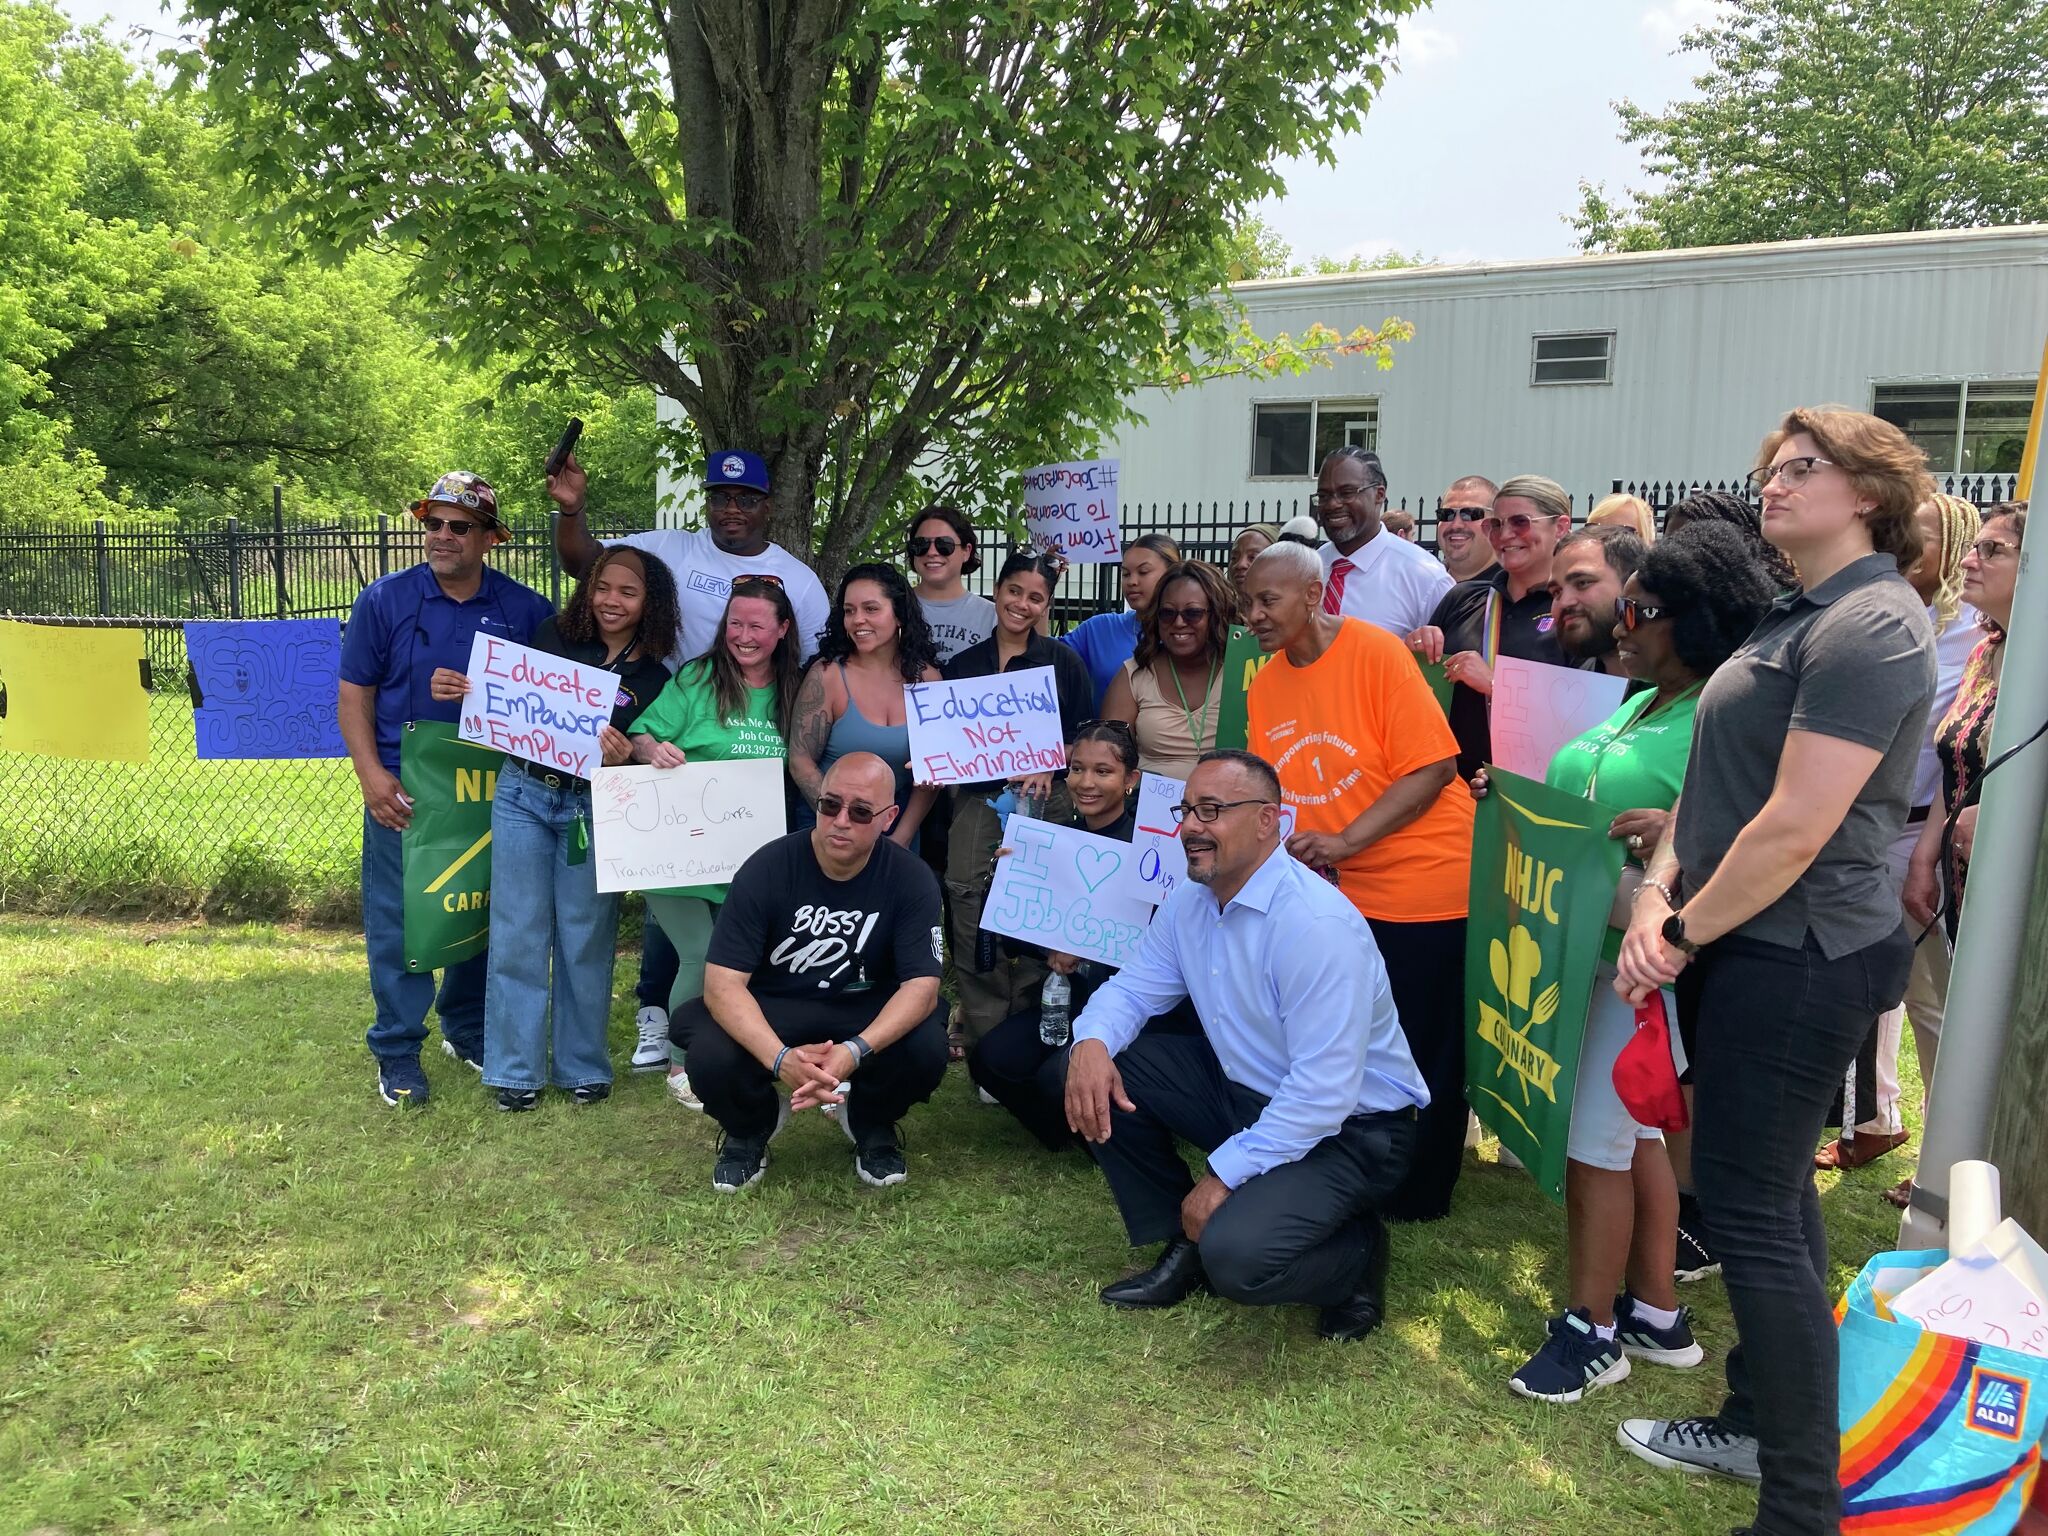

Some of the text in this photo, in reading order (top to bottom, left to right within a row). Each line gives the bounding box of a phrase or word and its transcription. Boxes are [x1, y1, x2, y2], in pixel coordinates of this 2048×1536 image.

[1066, 527, 1119, 555] From
[693, 574, 733, 597] LEV
[930, 623, 981, 645] THA'S
[484, 638, 607, 709] Educate.
[908, 675, 1058, 726] Education
[726, 717, 778, 730] Ask Me Ab
[738, 730, 757, 741] Job
[963, 721, 1022, 748] Not
[923, 740, 1068, 784] Elimination
[1273, 732, 1321, 774] Empowering
[1322, 731, 1358, 757] Futures
[1311, 756, 1324, 782] 1
[1338, 768, 1363, 791] Time
[625, 777, 688, 832] Job
[1503, 841, 1565, 926] NHJC
[993, 880, 1062, 932] Job
[1493, 1017, 1546, 1084] CULINARY
[1975, 1406, 2016, 1428] ALDI
